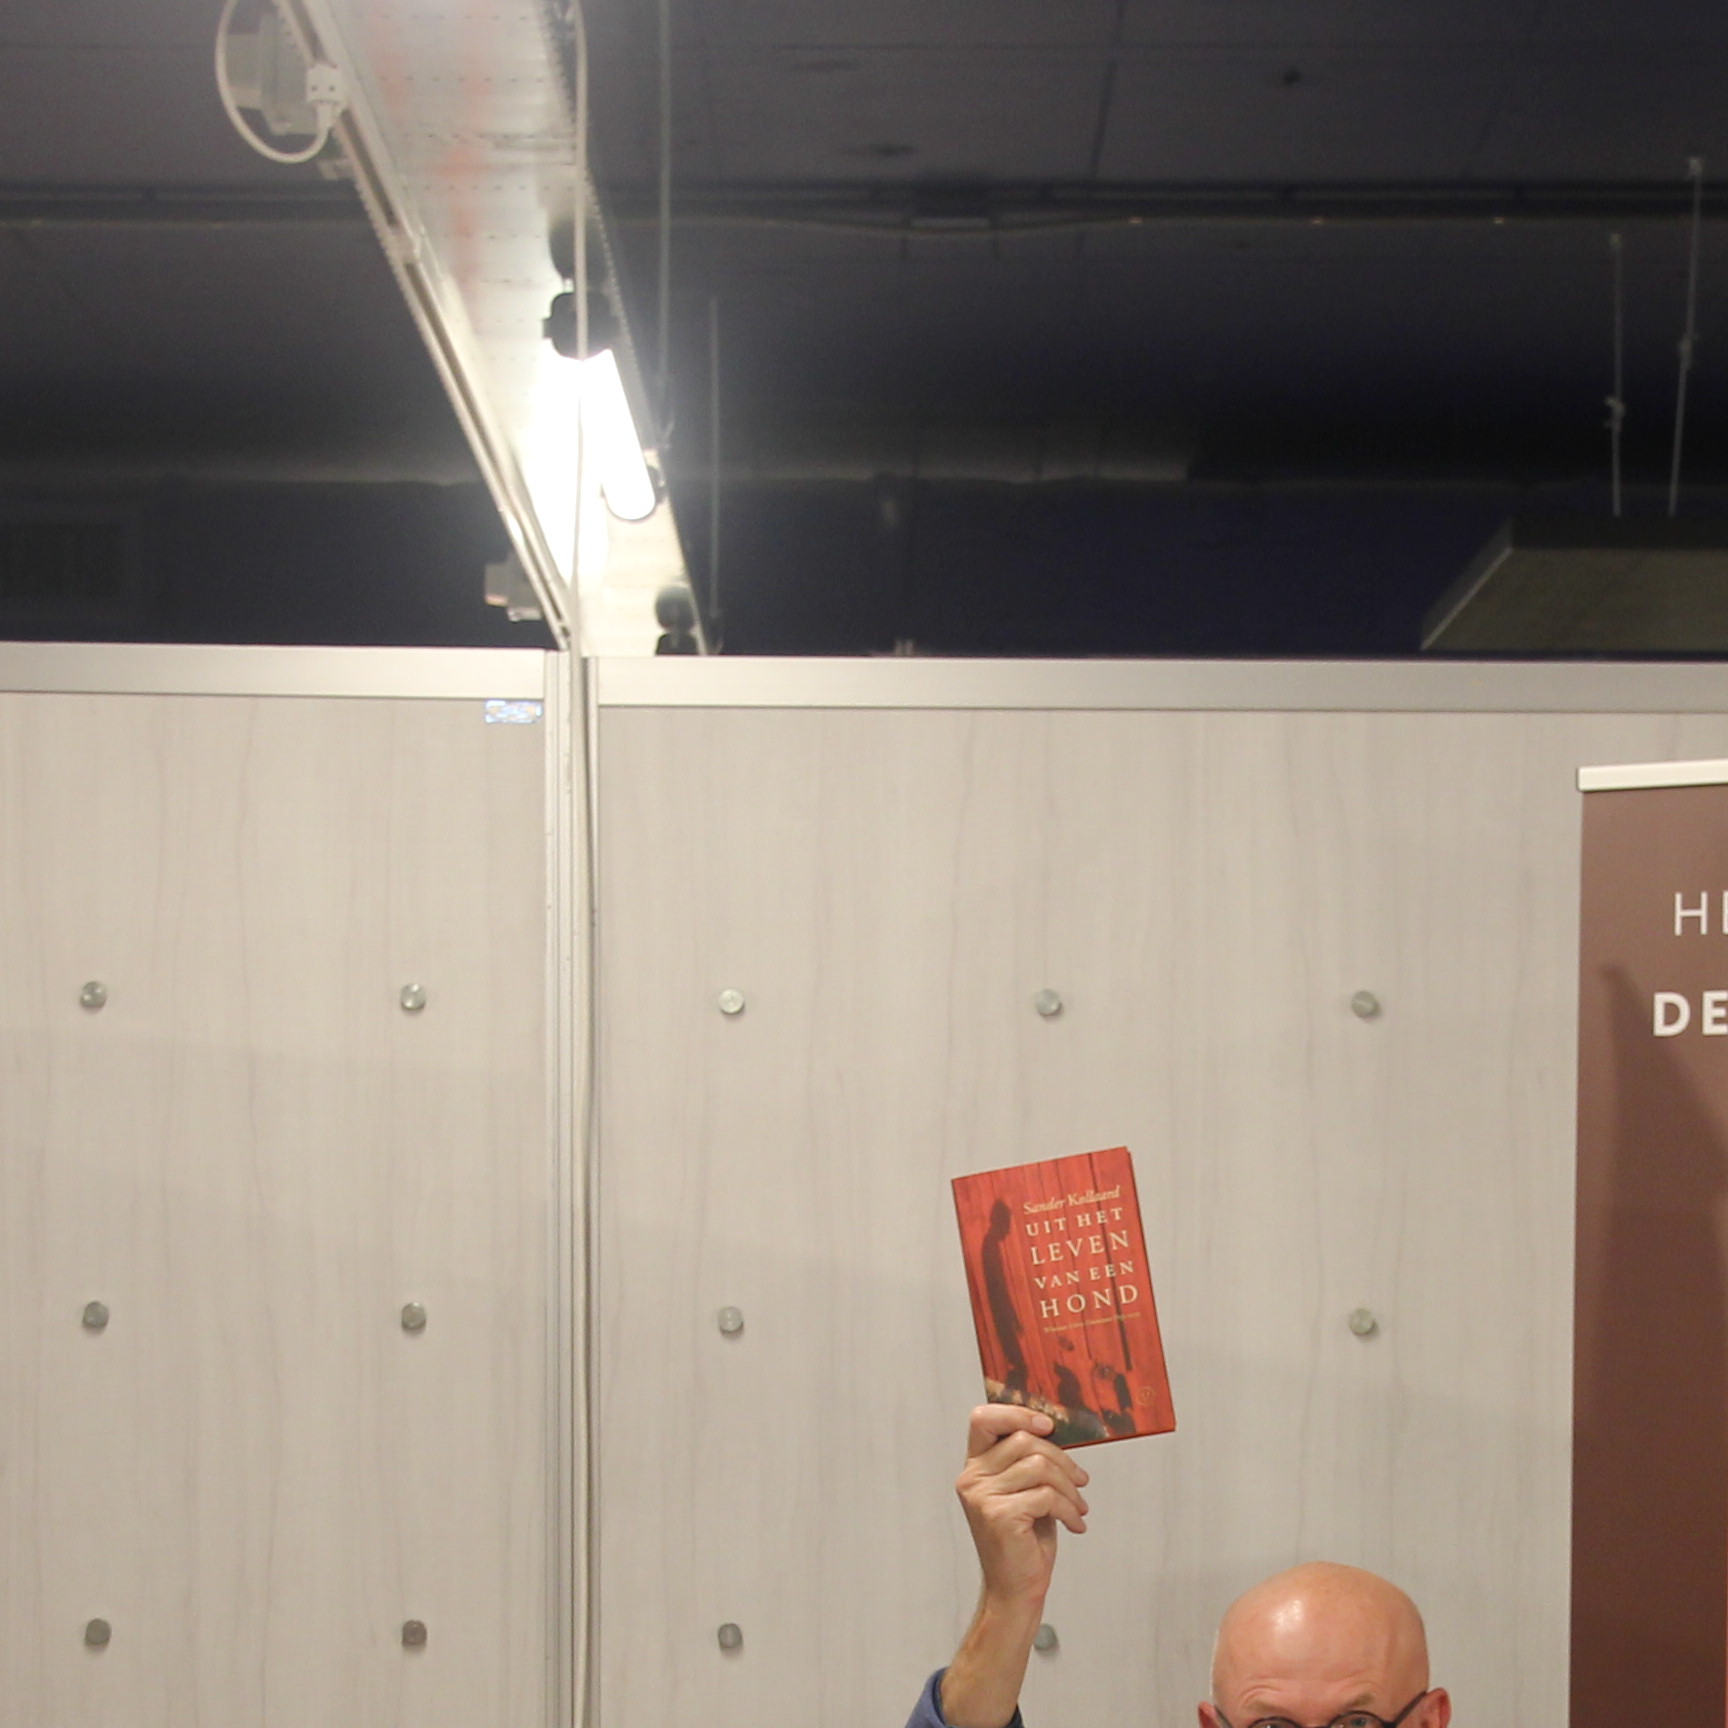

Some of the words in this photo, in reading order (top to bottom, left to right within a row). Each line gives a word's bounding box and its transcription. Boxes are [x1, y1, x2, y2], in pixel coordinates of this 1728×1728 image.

[1023, 1196, 1066, 1215] Sander
[1026, 1217, 1066, 1236] UIT
[1077, 1207, 1122, 1227] HET
[1031, 1230, 1129, 1265] LEVEN
[1034, 1270, 1079, 1289] VAN
[1090, 1261, 1133, 1280] EEN
[1040, 1285, 1138, 1318] HOND
